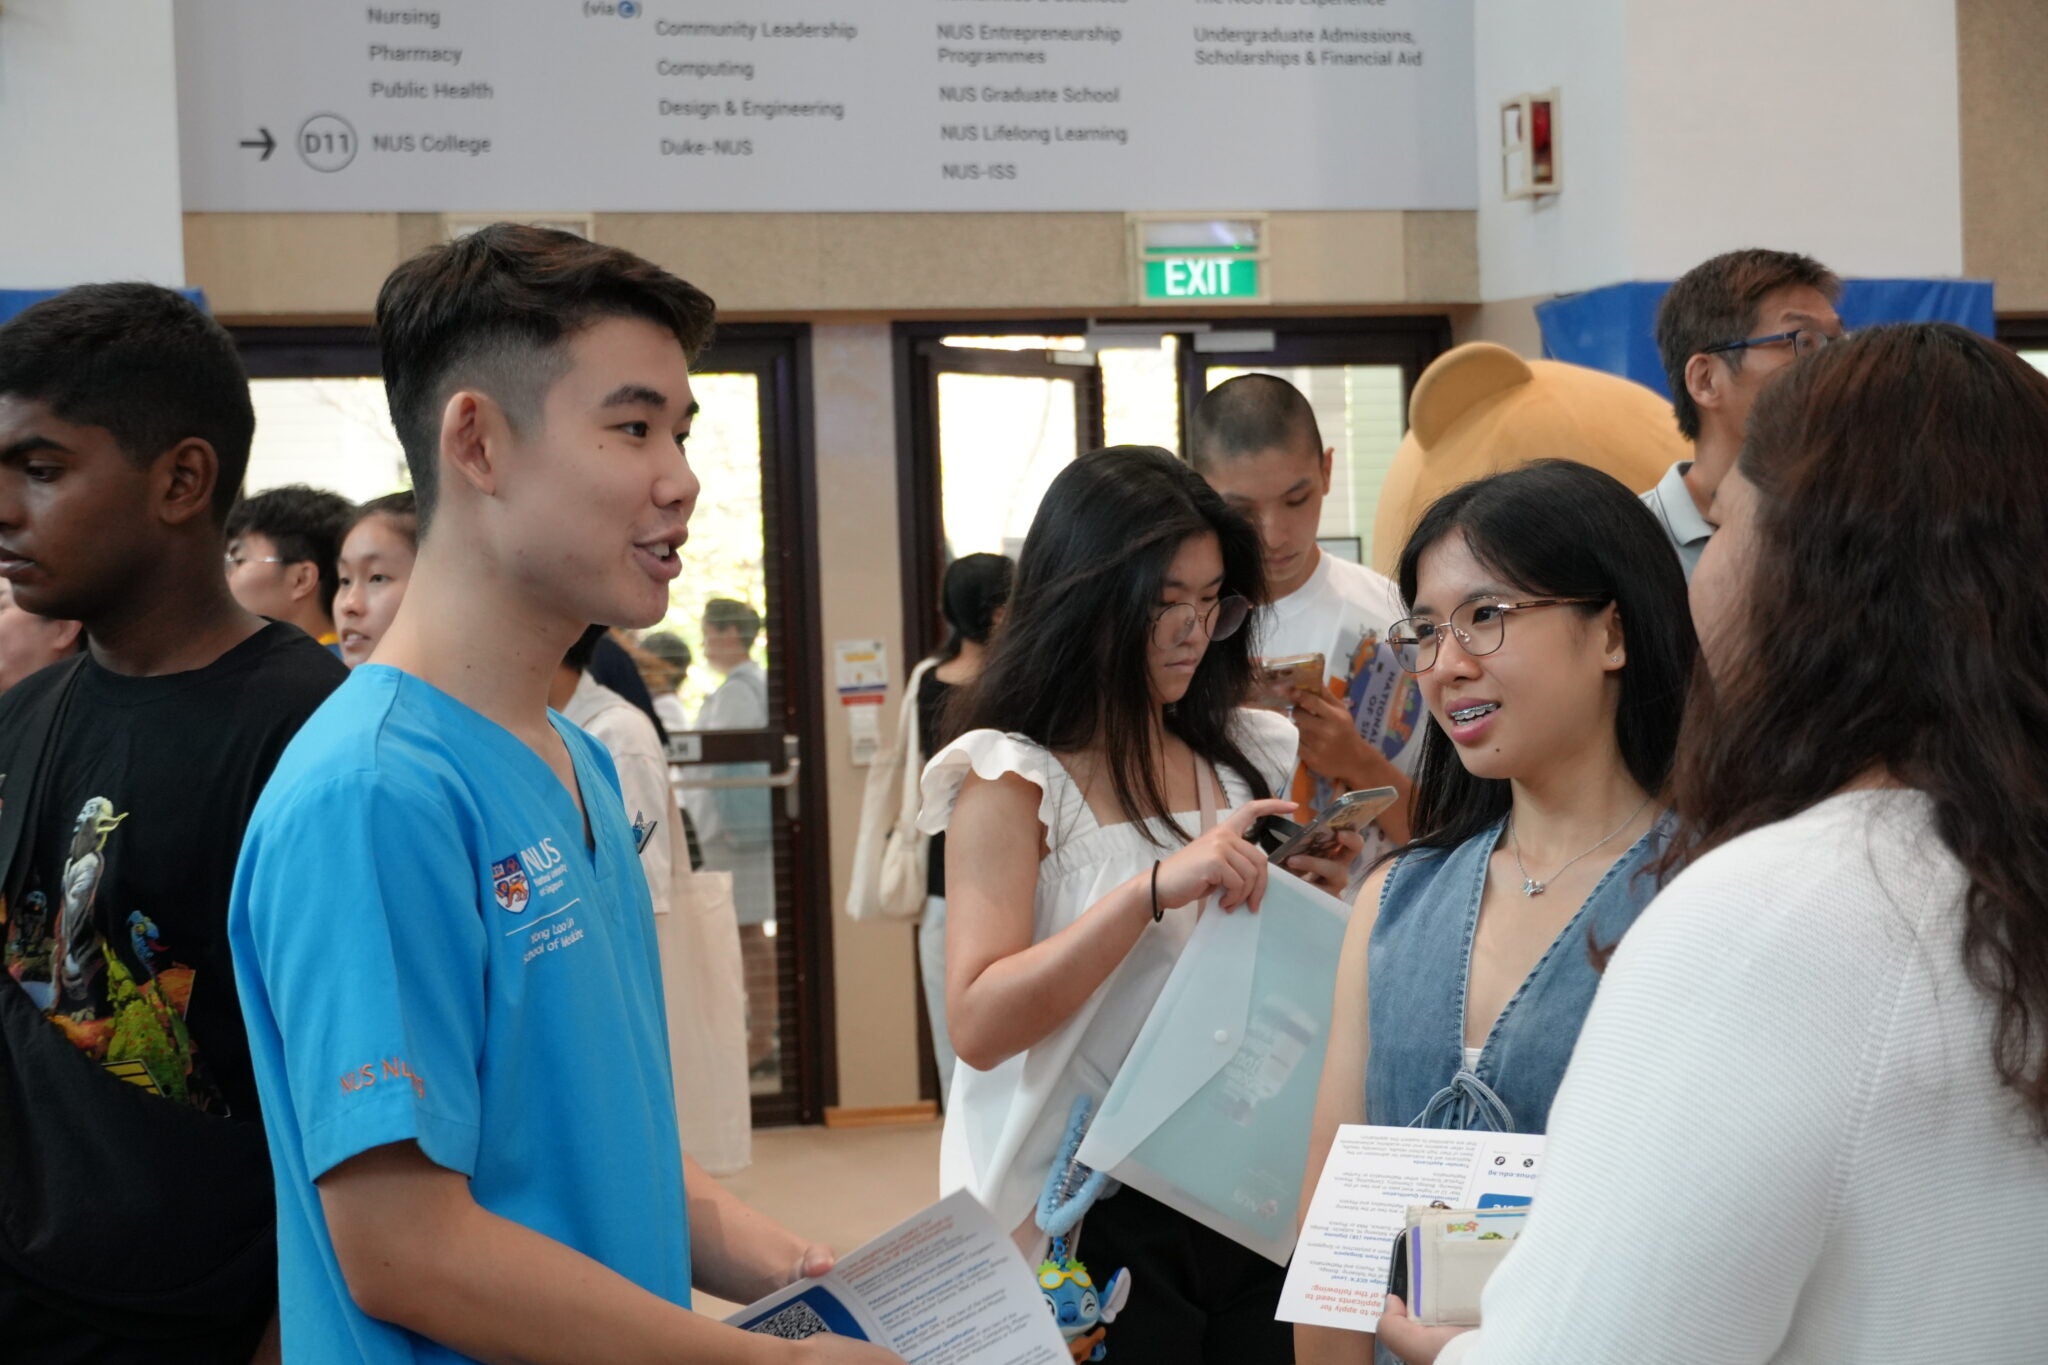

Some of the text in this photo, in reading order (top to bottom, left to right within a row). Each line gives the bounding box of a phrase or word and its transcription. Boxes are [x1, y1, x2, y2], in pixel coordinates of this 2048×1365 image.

[367, 8, 440, 29] Nursing
[656, 20, 858, 42] Community Leadership
[937, 25, 1122, 44] NUS Entrepreneurship
[1194, 27, 1415, 45] Undergraduate Admissions,
[369, 45, 462, 66] Pharmacy
[938, 48, 1046, 67] Programmes
[1195, 51, 1422, 67] Scholarships & Financial Aid
[657, 60, 754, 81] Computing
[370, 82, 493, 98] Public Health
[939, 87, 1119, 102] NUS Graduate School
[659, 100, 844, 120] Design & Engineering
[305, 134, 349, 154] D11
[941, 126, 1128, 145] NUS Lifelong Learning
[373, 135, 491, 156] NUS College
[660, 139, 753, 155] Duke-NUS
[942, 164, 1016, 179] NUS-ISS
[1165, 258, 1234, 295] EXIT
[520, 837, 561, 876] NUS
[340, 1064, 376, 1096] NUS
[1310, 1284, 1352, 1295] following:
[1314, 1294, 1336, 1302] need
[1333, 1305, 1357, 1313] apply
[1337, 1296, 1381, 1307] applicants
